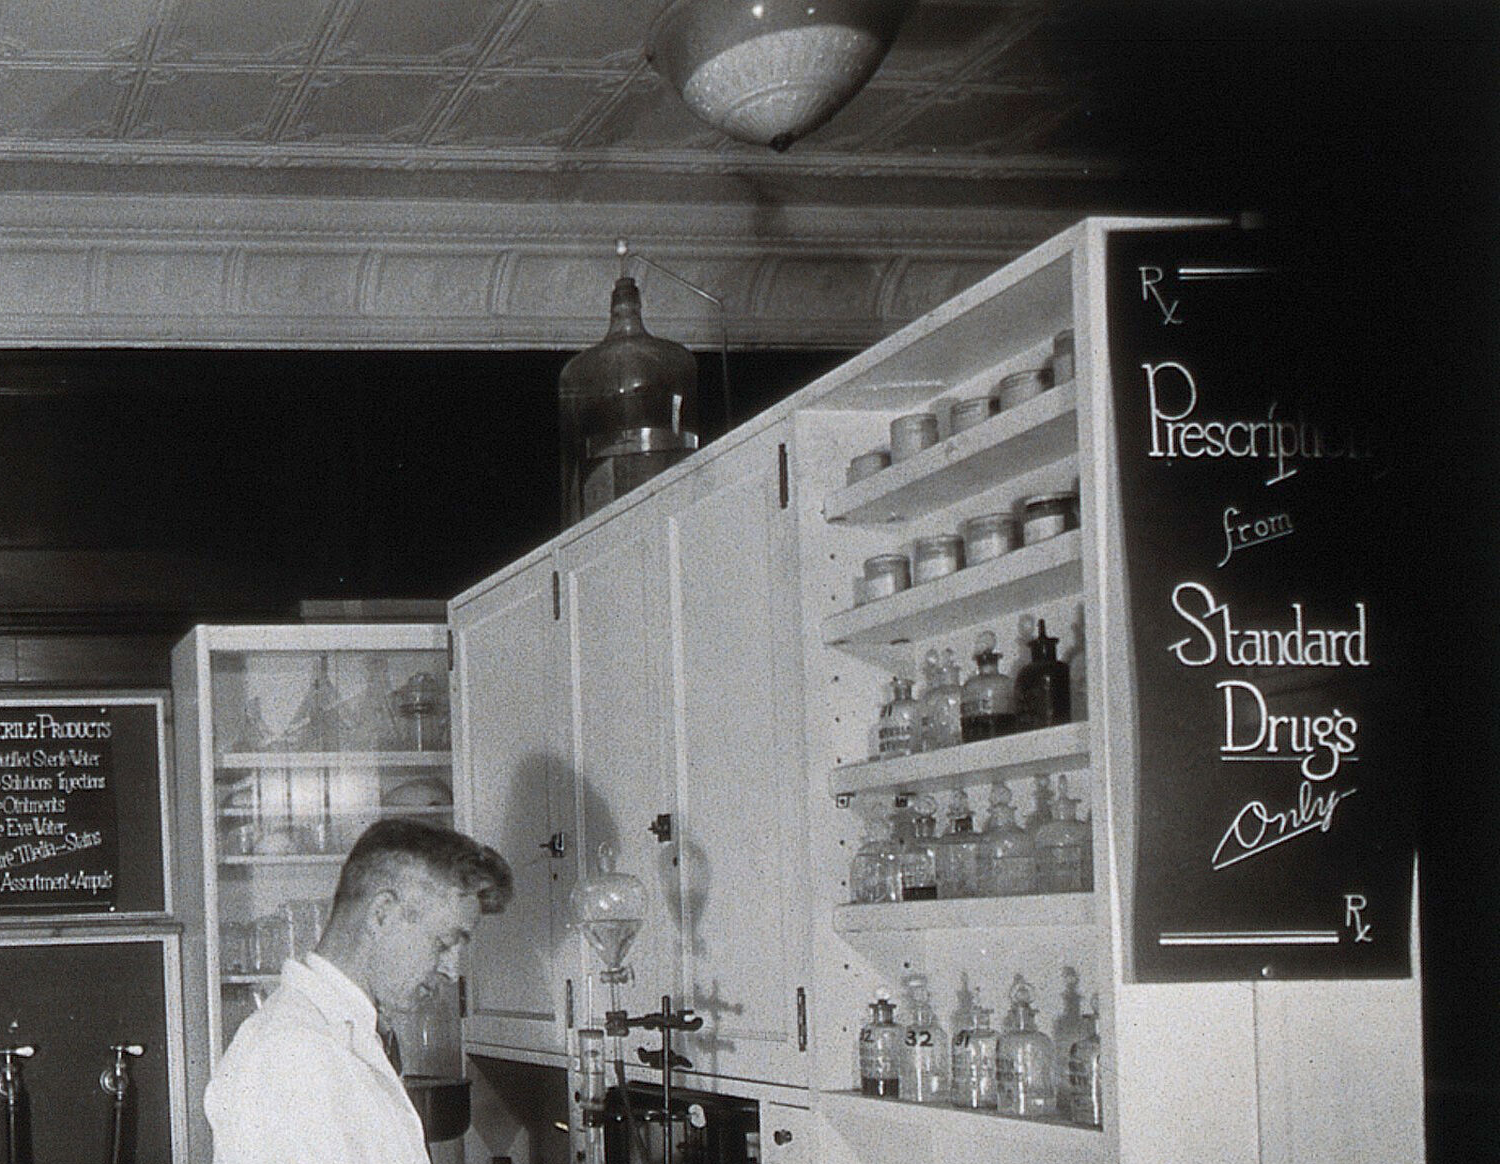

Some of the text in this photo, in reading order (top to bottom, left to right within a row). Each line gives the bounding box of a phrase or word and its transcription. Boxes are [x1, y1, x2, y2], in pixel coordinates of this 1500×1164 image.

[1217, 507, 1293, 568] from
[1168, 582, 1370, 666] Standard
[36, 713, 112, 739] PRODUCTS
[1215, 680, 1358, 780] Drugs
[1211, 781, 1357, 865] Only
[905, 1031, 933, 1047] 32
